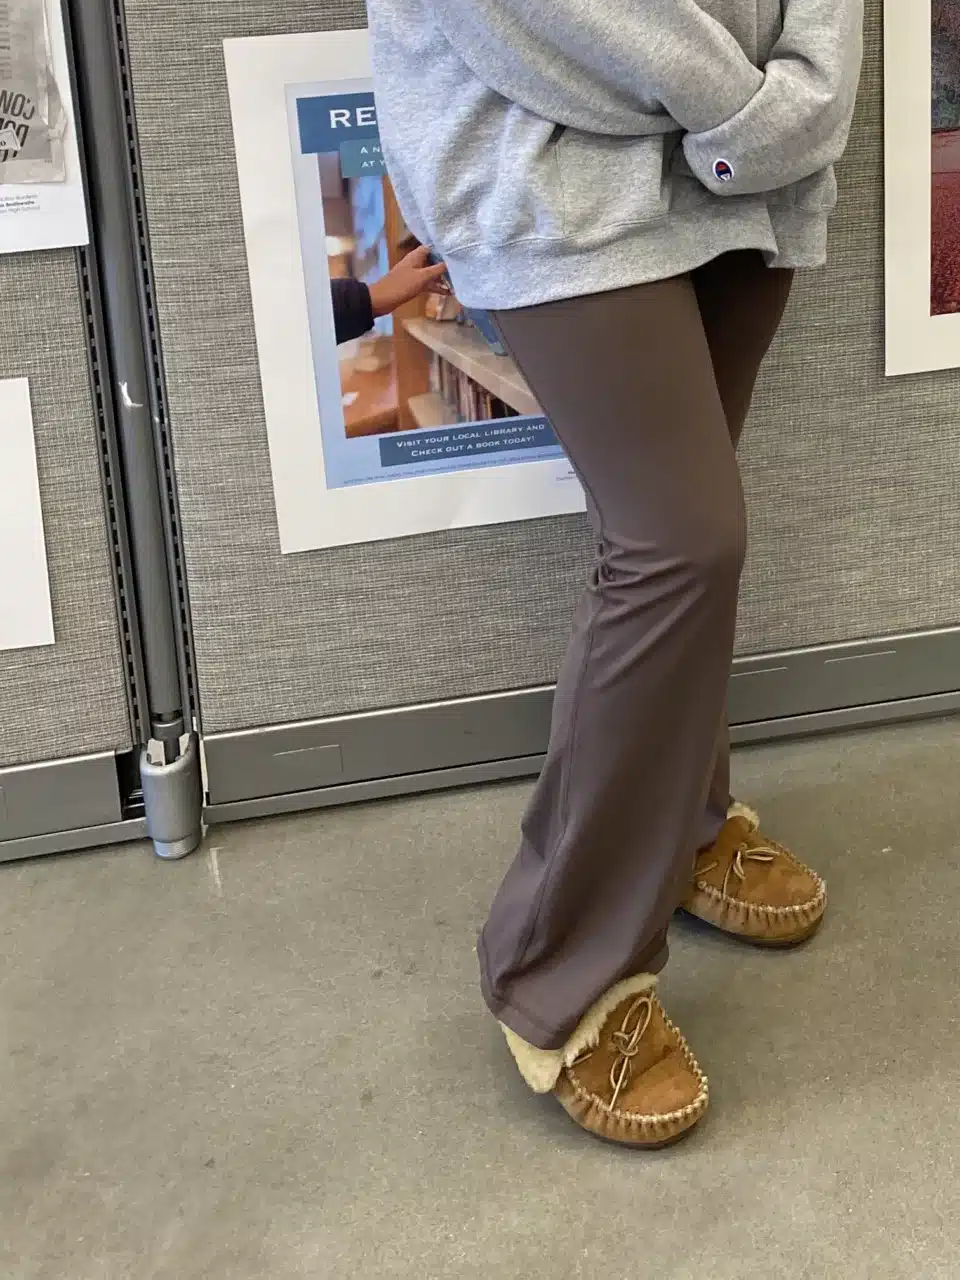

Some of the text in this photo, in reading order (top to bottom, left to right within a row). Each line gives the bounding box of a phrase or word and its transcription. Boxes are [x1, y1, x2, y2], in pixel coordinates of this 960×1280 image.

[361, 160, 375, 169] AT
[396, 439, 421, 448] VISIT
[424, 435, 449, 444] YOUR
[452, 432, 480, 441] LOCAL
[484, 427, 523, 437] LIBRARY
[411, 447, 443, 457] CHECK
[445, 444, 464, 453] OUT
[476, 440, 501, 448] BOOK
[504, 436, 535, 446] TODAY!
